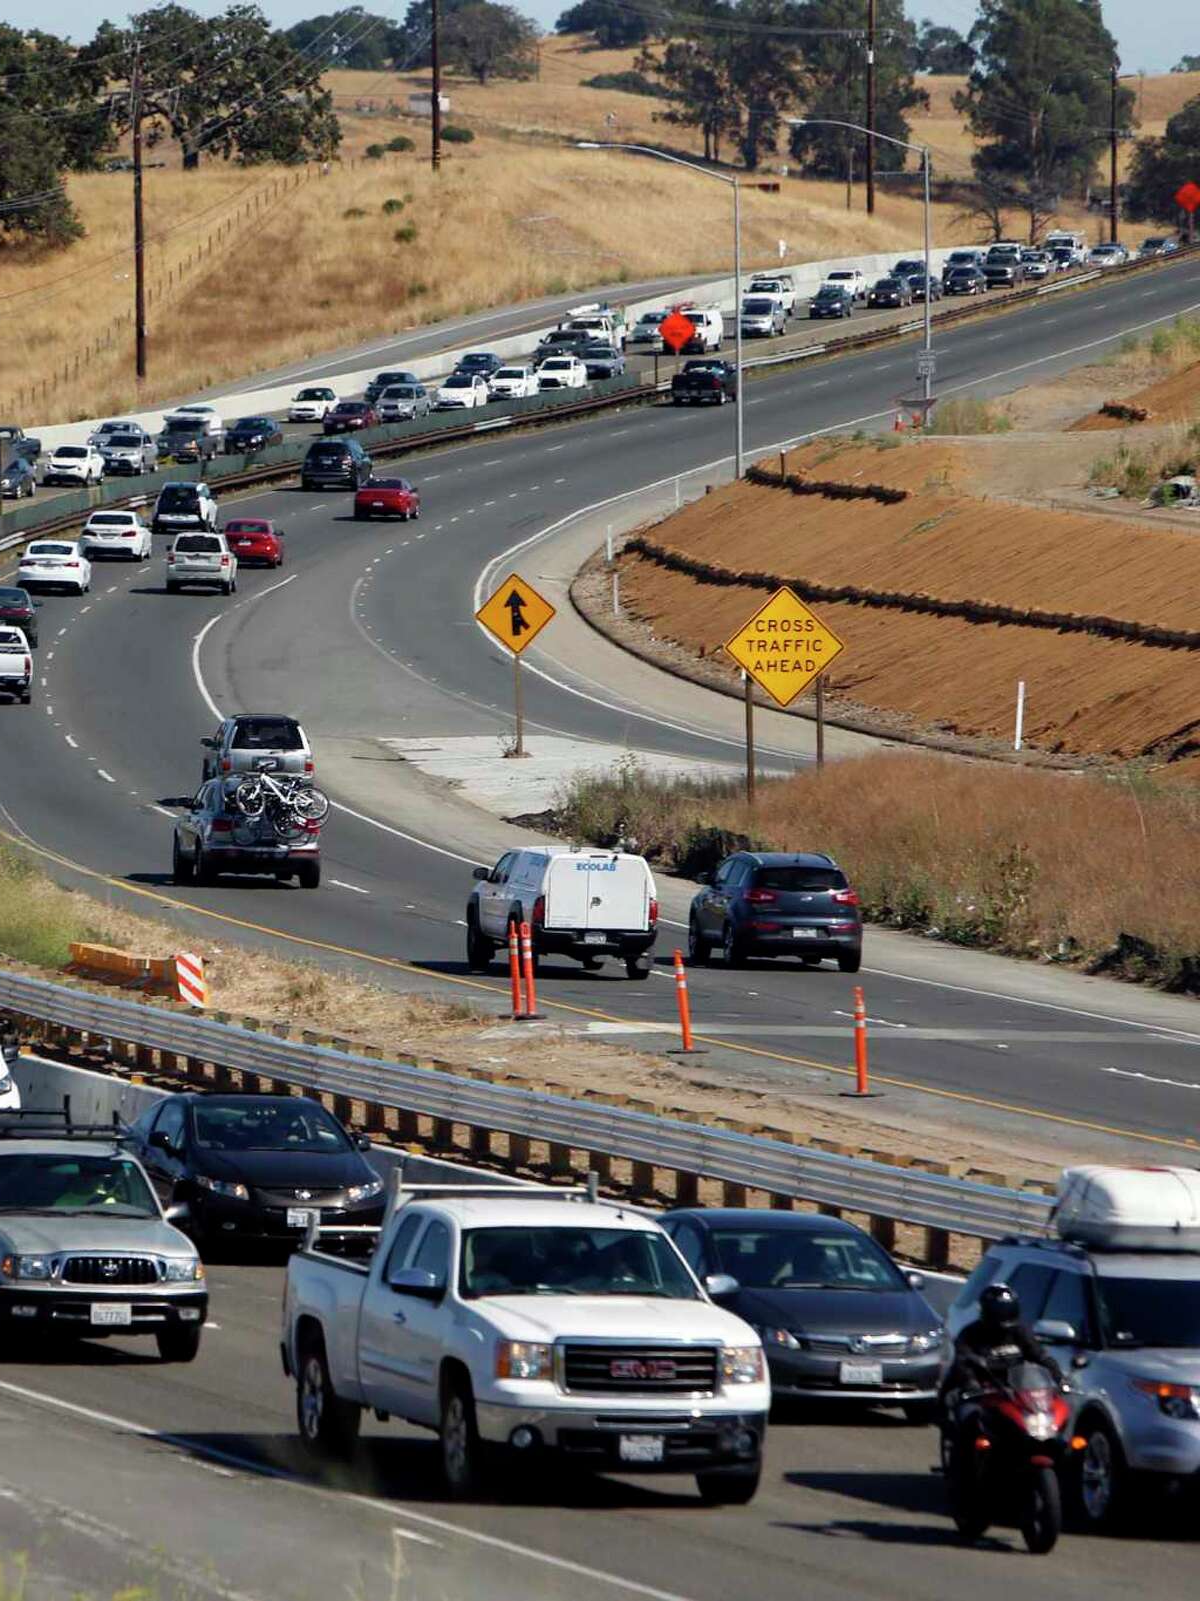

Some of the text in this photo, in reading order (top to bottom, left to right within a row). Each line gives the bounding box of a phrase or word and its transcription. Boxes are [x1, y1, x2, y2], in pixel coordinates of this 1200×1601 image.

[755, 619, 815, 632] CROSS
[745, 639, 822, 652] TRAFFIC
[753, 659, 816, 672] AHEAD
[576, 862, 616, 873] ECOLAB
[609, 1359, 677, 1379] GMC
